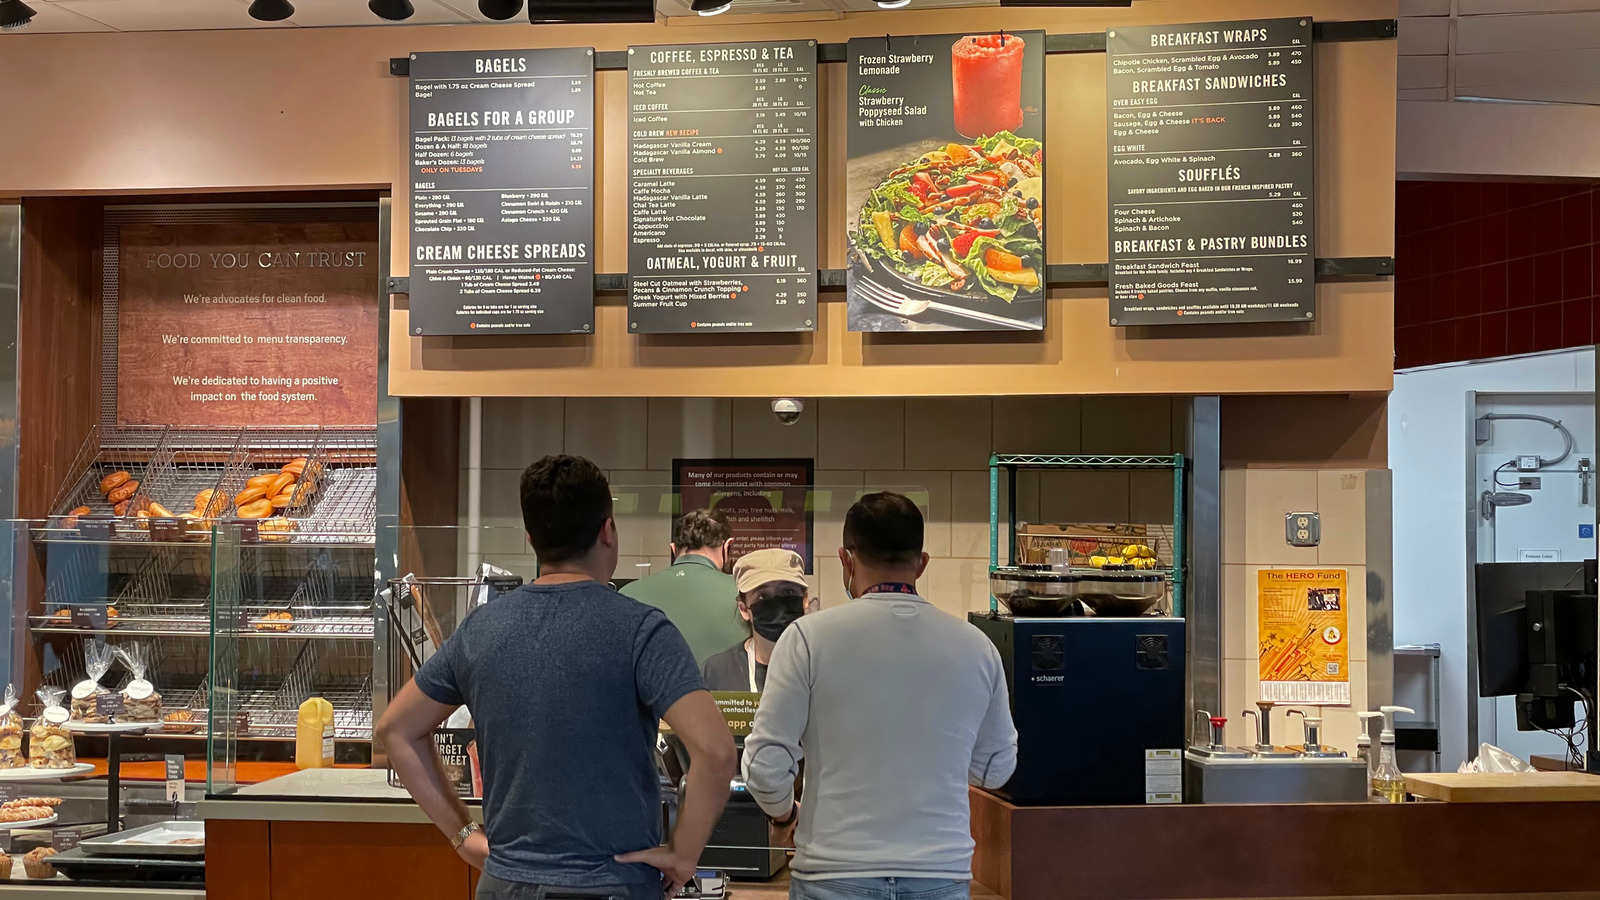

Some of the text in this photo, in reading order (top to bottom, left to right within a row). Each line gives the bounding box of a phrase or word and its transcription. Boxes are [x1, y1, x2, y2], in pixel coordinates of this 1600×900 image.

[1151, 29, 1267, 47] BREAKFAST WRAPS
[650, 48, 793, 64] COFFEE, ESPRESSO & TEA
[889, 55, 934, 63] Strawberry
[476, 57, 526, 73] BAGELS
[859, 66, 900, 75] Lemonade
[1133, 75, 1286, 93] BREAKFAST SANDWICHES
[859, 84, 887, 96] Classic
[859, 97, 904, 106] Strawberry
[859, 107, 926, 117] Poppyseed Salad
[428, 110, 574, 127] BAGELS FOR A GROUP
[1179, 165, 1241, 181] SOUFFLÉS
[1115, 235, 1307, 252] BREAKFAST & PASTRY BUNDLES
[417, 243, 586, 260] CREAM CHEESE SPREADS
[147, 252, 366, 269] FOOD YOU CAN TRUST
[647, 255, 797, 269] OATMEAL, YOGURT & FRUIT
[184, 294, 326, 304] We're advocates for clean food.
[162, 334, 188, 343] We're
[191, 334, 241, 343] committed
[244, 334, 253, 343] to
[286, 334, 348, 345] transparency.
[173, 376, 199, 385] We're
[202, 376, 247, 385] dedicated
[250, 376, 259, 385] to
[262, 376, 292, 387] having
[302, 376, 338, 387] positive
[190, 392, 222, 402] impact
[241, 392, 256, 401] the
[258, 392, 279, 401] food
[282, 392, 317, 402] system.
[728, 721, 746, 729] app
[434, 734, 453, 743] ON'T
[434, 745, 462, 754] RGET
[442, 756, 467, 765] WEET
